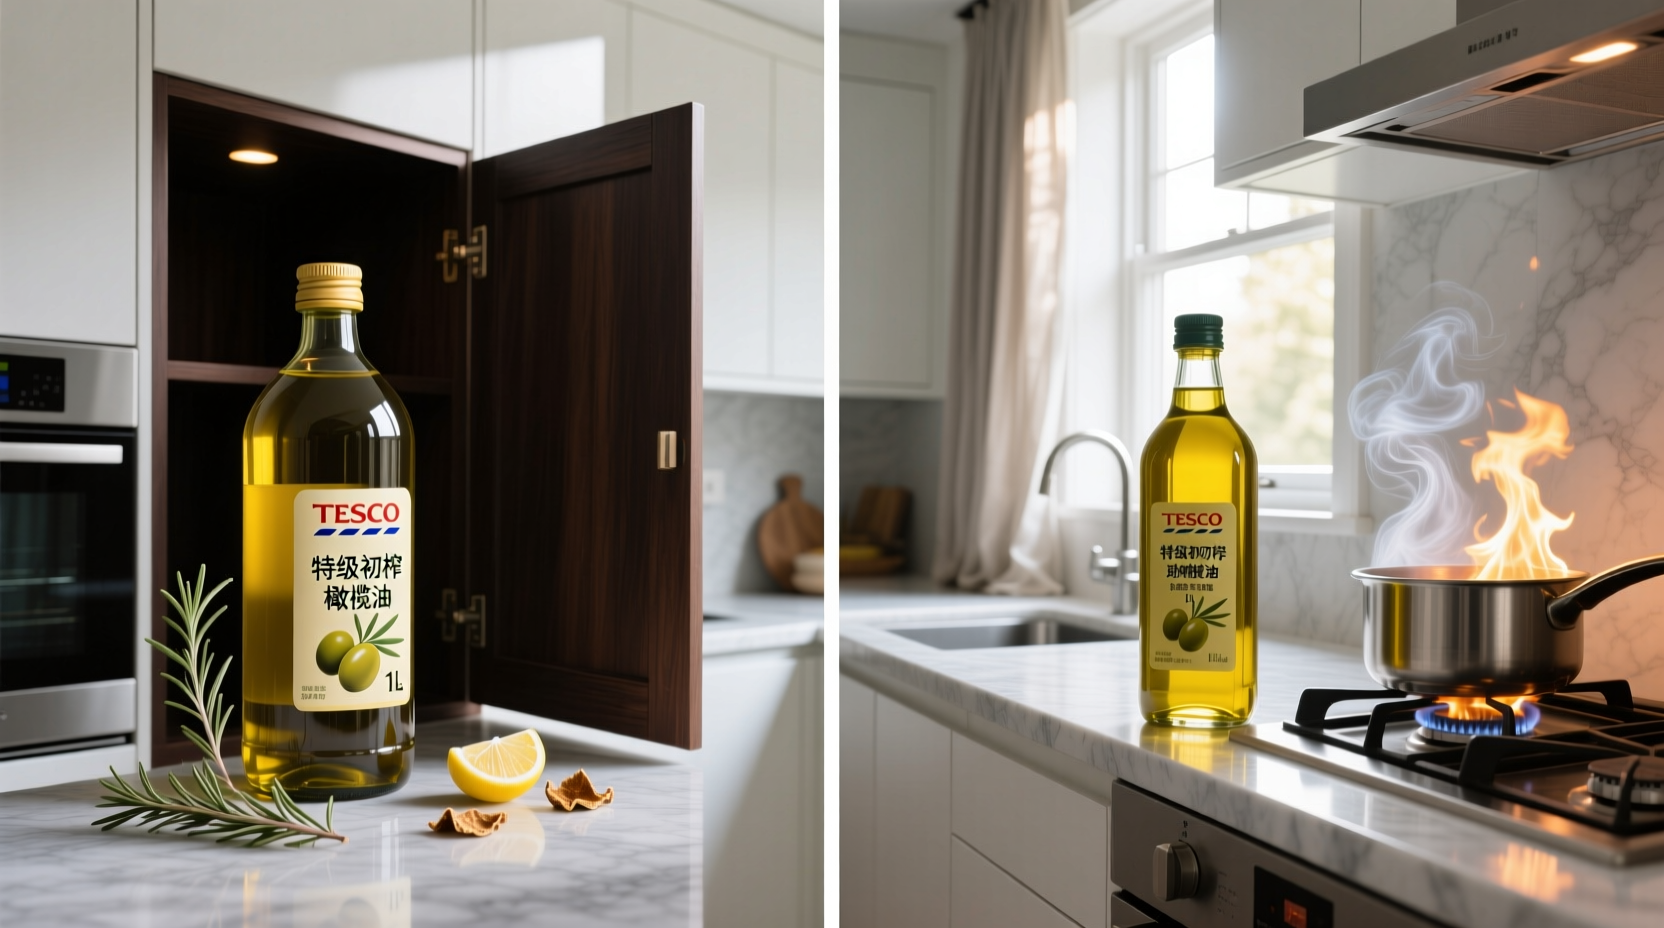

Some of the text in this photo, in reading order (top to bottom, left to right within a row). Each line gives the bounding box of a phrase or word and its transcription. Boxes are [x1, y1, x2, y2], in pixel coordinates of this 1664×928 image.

[312, 502, 400, 524] TESCO
[1161, 512, 1223, 527] TESCO
[311, 552, 403, 582] 特级初榨
[323, 583, 392, 612] 橄榄油
[385, 670, 404, 692] 1L
